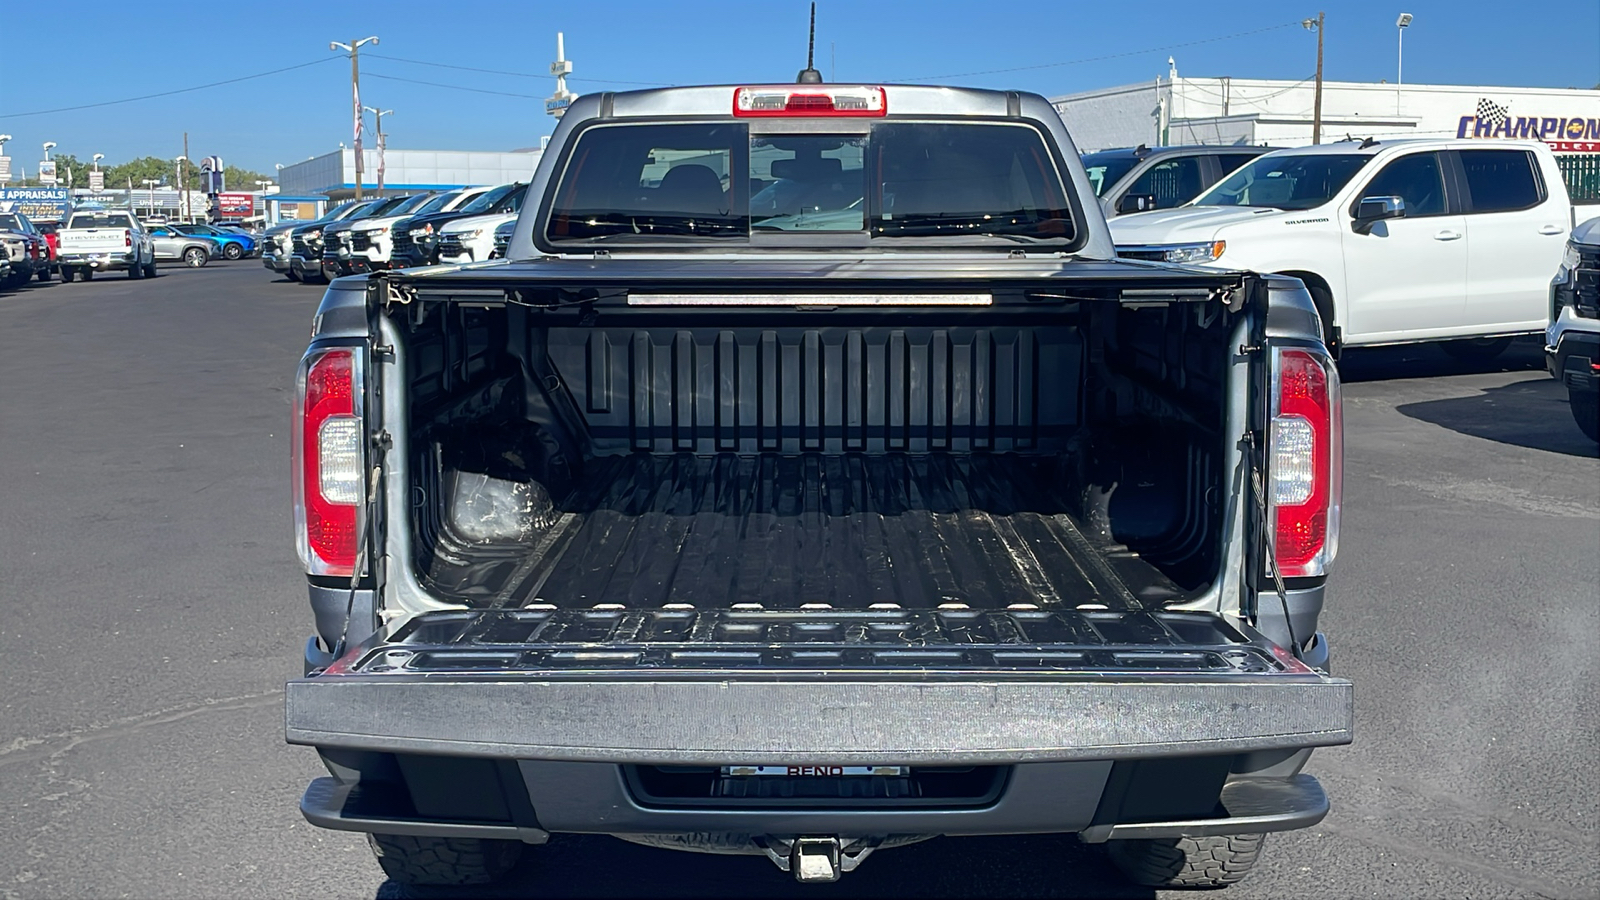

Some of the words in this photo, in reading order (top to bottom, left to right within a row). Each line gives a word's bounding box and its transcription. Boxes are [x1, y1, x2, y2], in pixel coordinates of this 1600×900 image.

[1456, 115, 1600, 139] CHAMPION
[7, 191, 67, 199] APPRAISALS!
[787, 765, 843, 776] RENO
